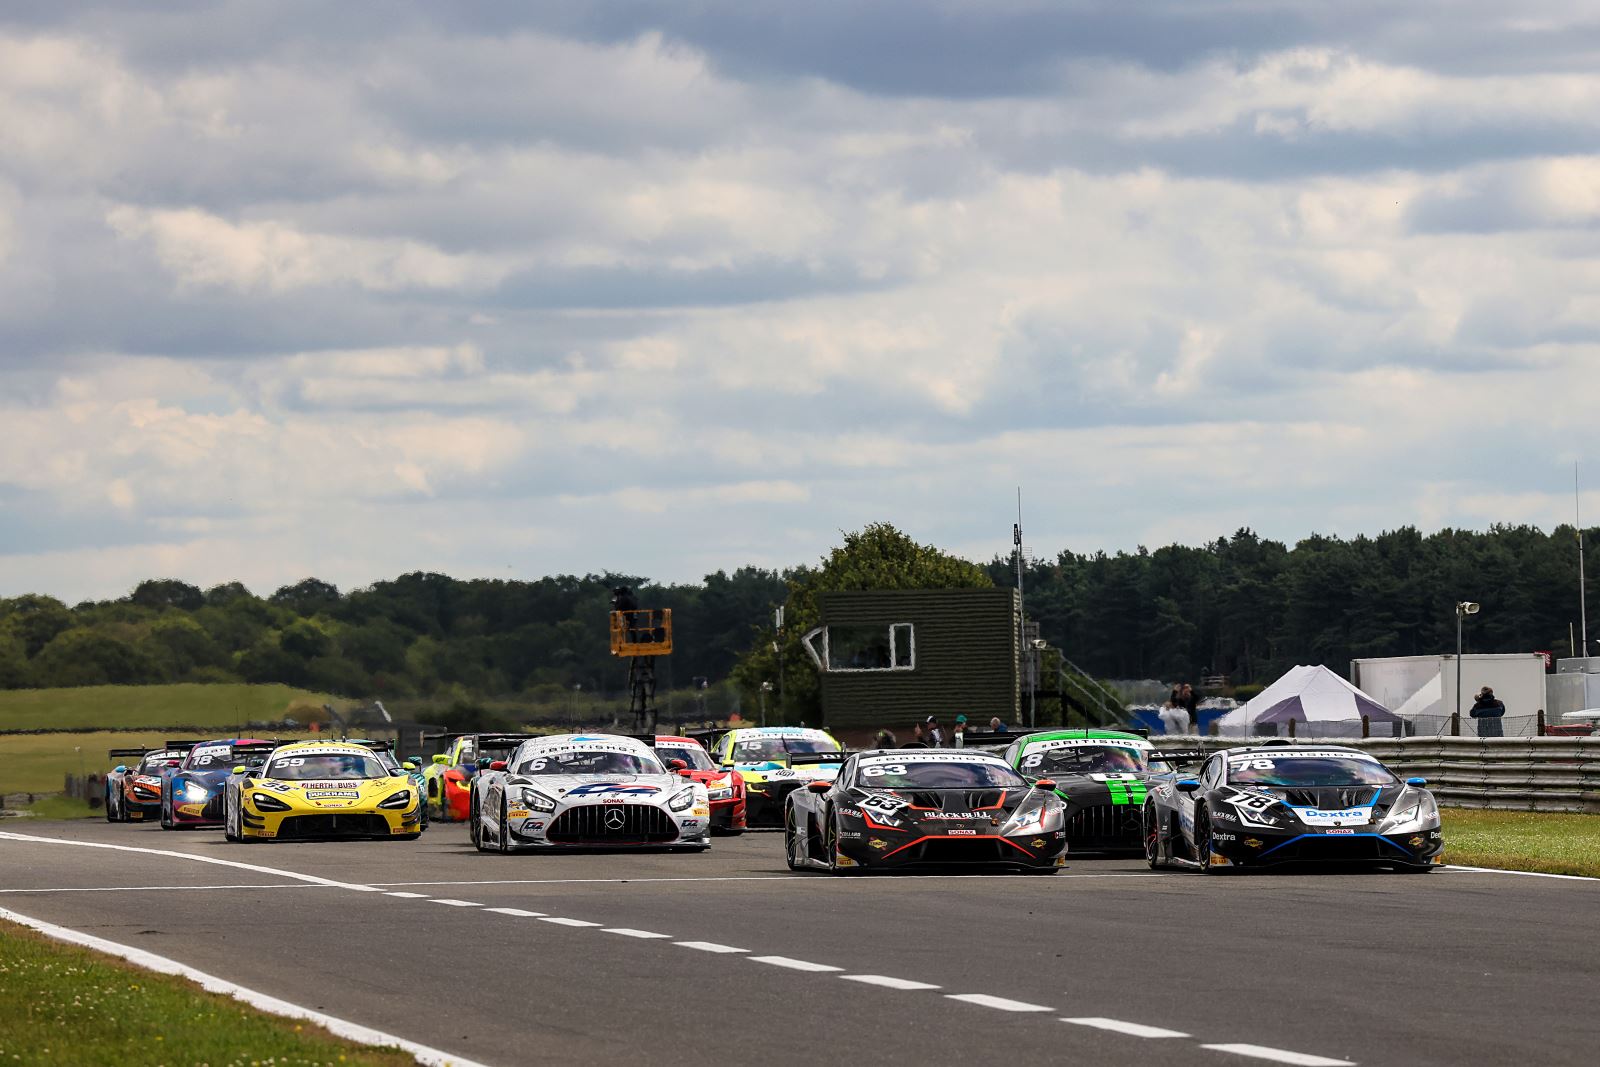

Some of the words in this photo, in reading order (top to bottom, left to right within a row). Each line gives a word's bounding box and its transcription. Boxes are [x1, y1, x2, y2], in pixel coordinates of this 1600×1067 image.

[740, 742, 762, 751] 15
[1041, 739, 1143, 748] #BRITISHGT
[540, 744, 638, 754] #BRITISHGT
[193, 756, 212, 766] 18
[275, 758, 305, 768] 59
[530, 759, 547, 771] 6
[1024, 754, 1043, 768] 8
[1230, 759, 1275, 771] 78
[863, 765, 907, 776] 63
[262, 782, 290, 791] 59
[864, 796, 903, 811] 63
[1234, 793, 1272, 808] 78
[924, 811, 961, 819] BLACK
[1305, 810, 1363, 818] Dextra
[1212, 832, 1236, 840] Dextra
